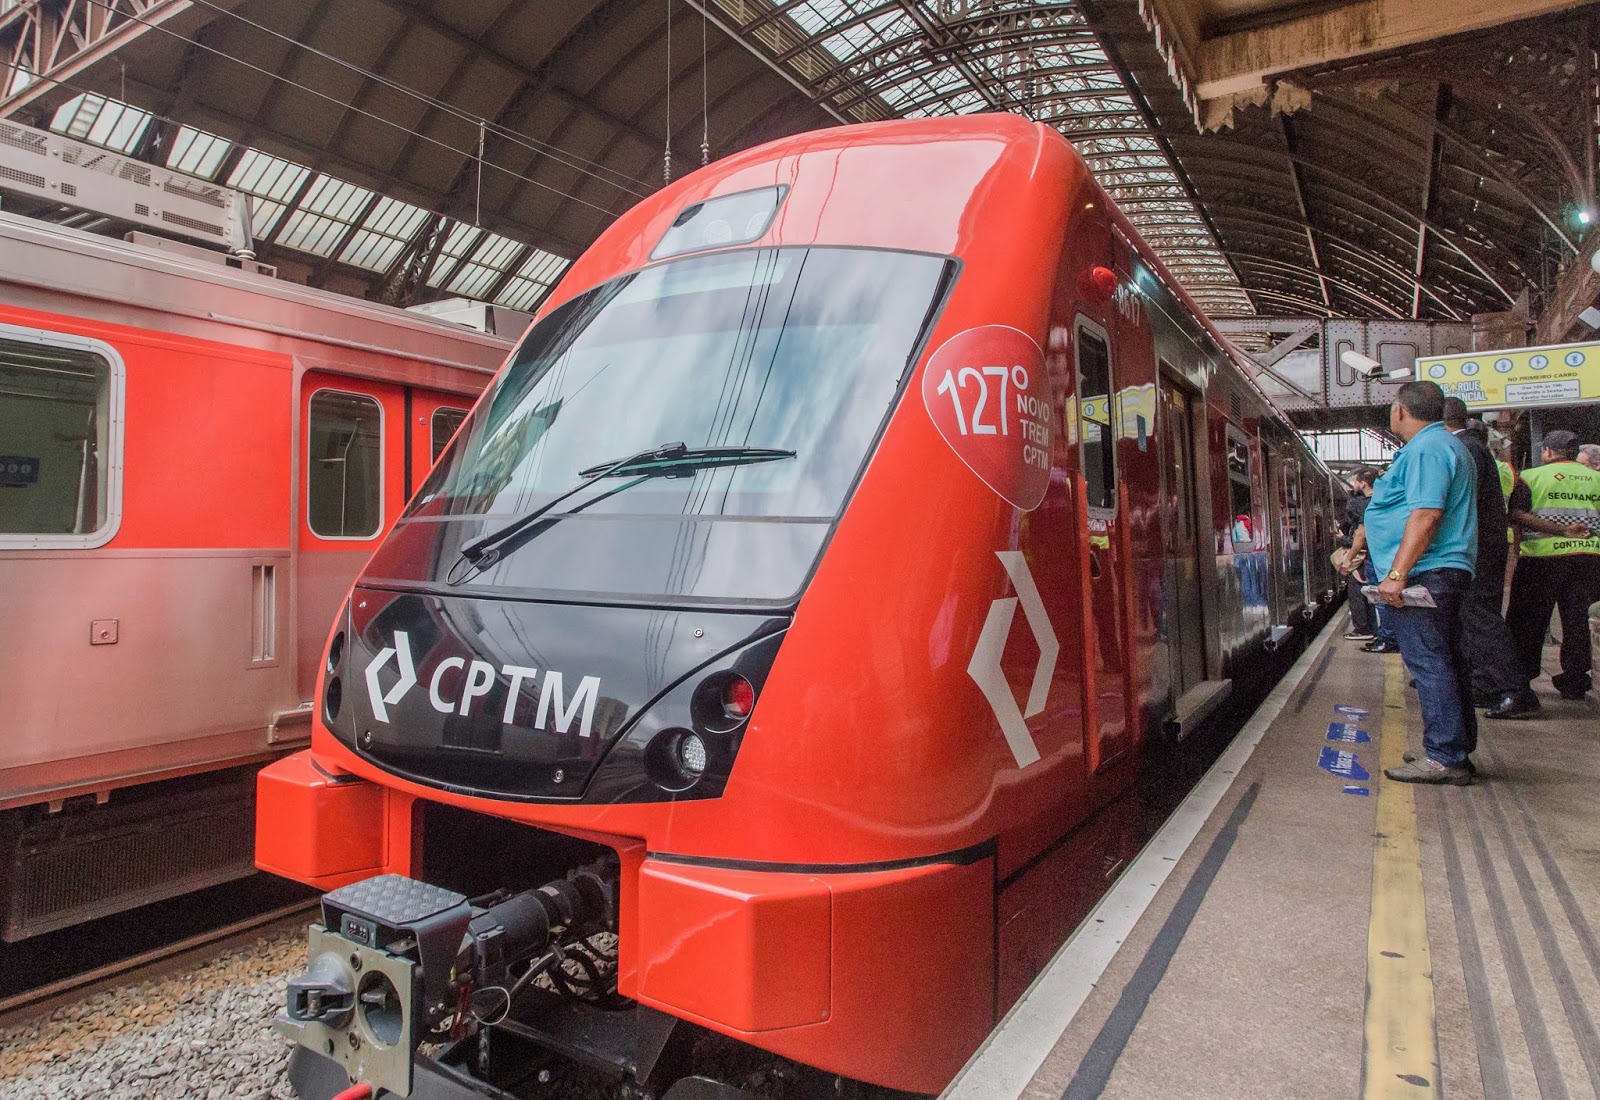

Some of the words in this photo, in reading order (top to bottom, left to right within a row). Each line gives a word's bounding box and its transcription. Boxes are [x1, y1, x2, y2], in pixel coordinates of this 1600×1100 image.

[1016, 394, 1050, 421] NOVO
[1020, 419, 1049, 448] TREM
[1023, 444, 1049, 471] CPTM
[1568, 474, 1593, 482] CPTM
[429, 656, 601, 737] CPTM
